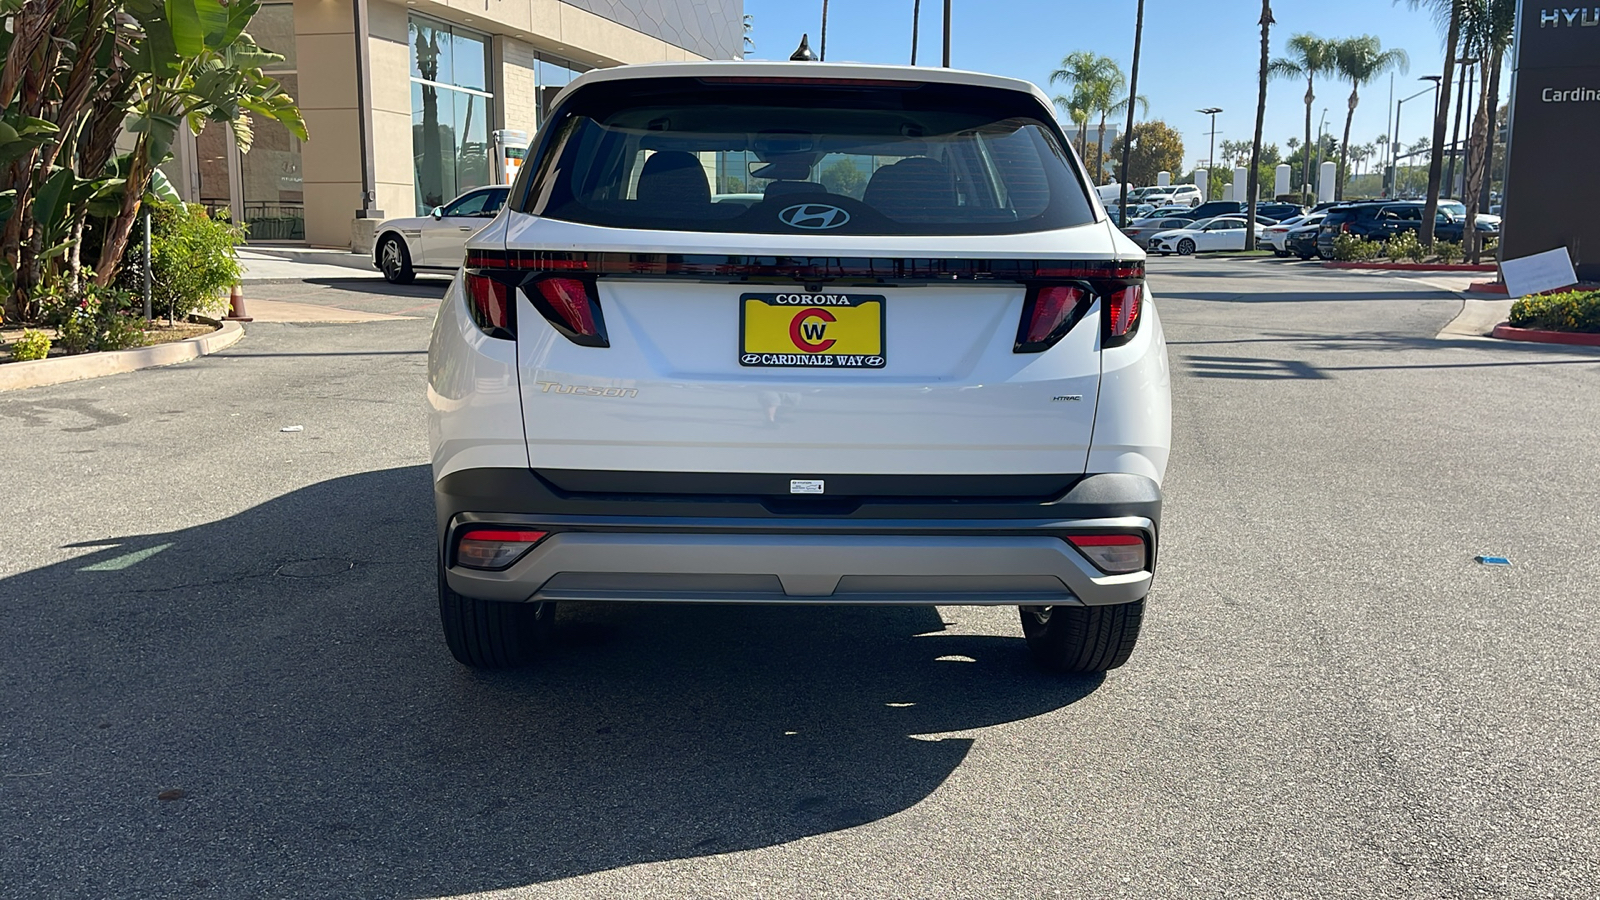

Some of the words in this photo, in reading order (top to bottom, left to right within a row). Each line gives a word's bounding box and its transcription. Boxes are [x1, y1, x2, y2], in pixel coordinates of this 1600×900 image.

[776, 294, 850, 305] CORONA
[762, 354, 833, 365] CARDINALE
[837, 355, 864, 366] WAY
